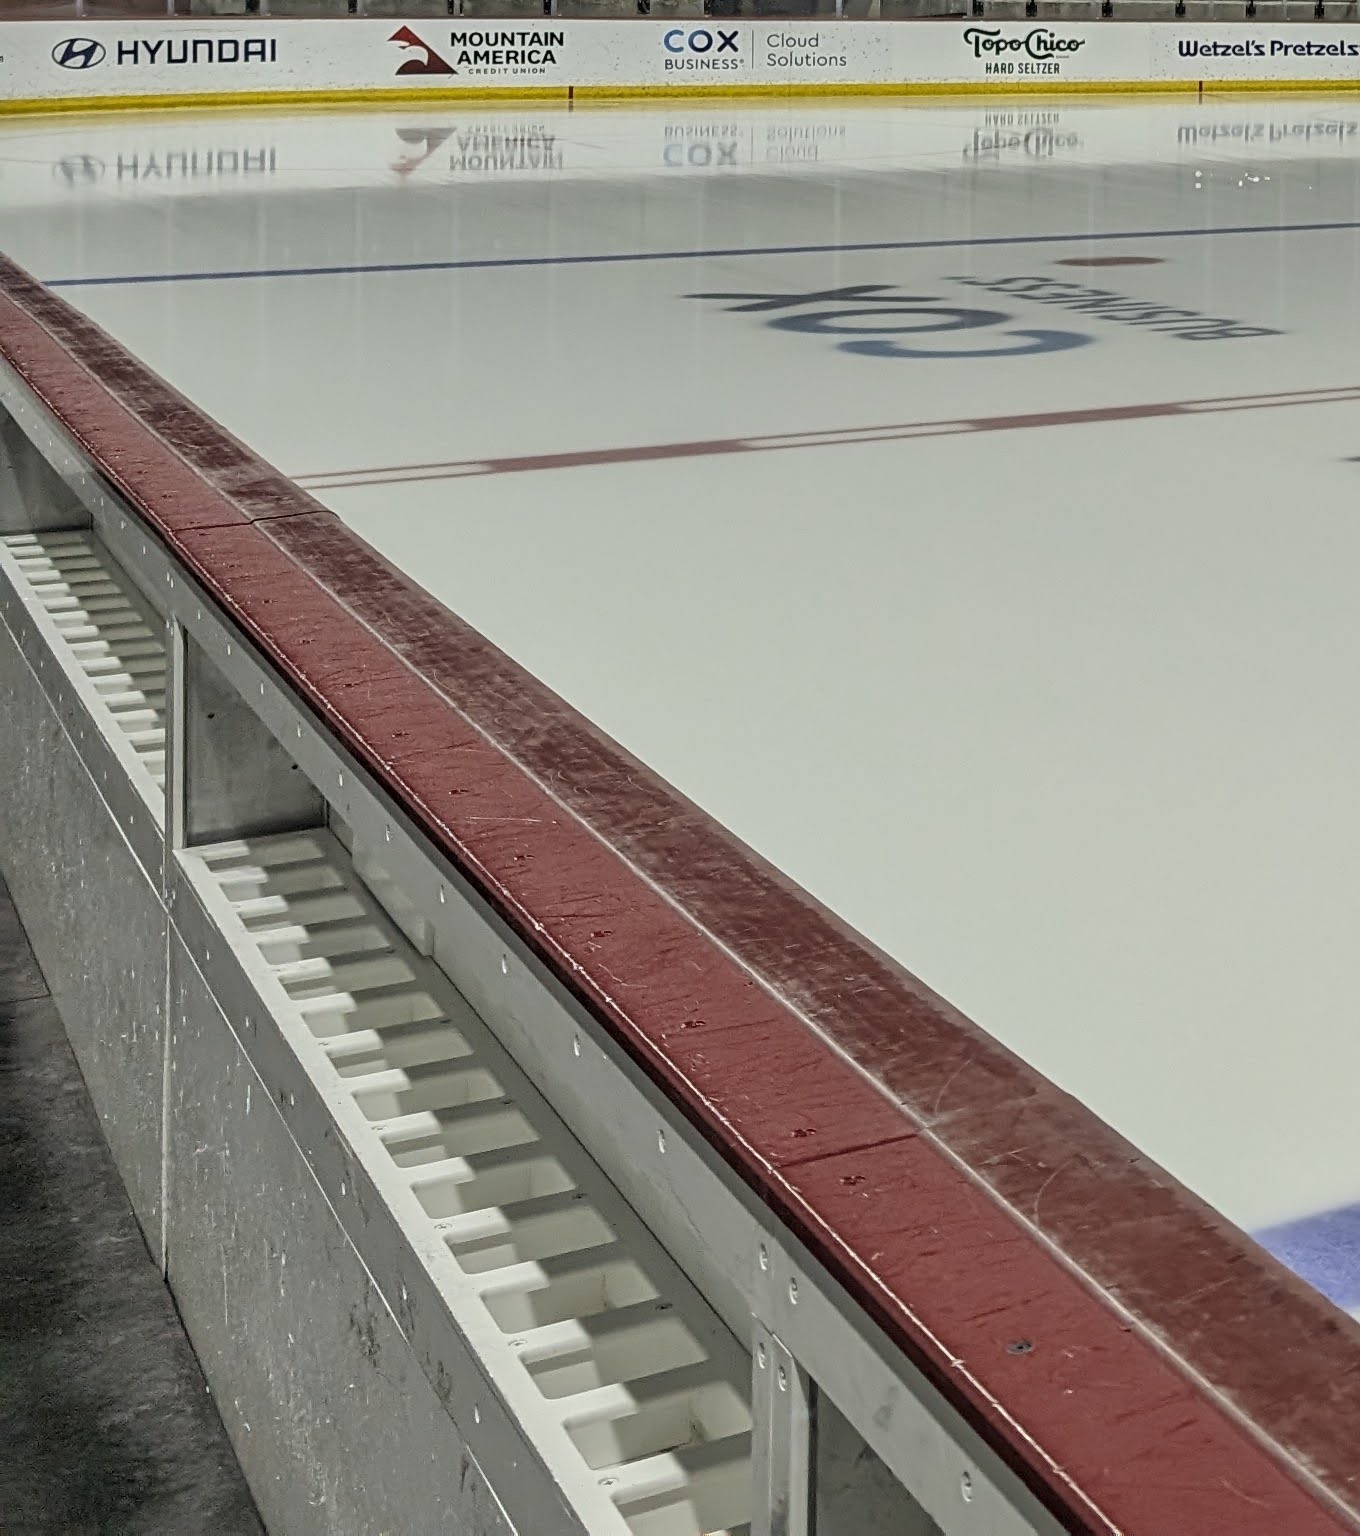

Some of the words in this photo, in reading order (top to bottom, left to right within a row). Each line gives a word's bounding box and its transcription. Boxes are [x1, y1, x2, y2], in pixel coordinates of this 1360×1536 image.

[450, 31, 565, 47] MOUNTAIN
[664, 29, 739, 53] COX
[766, 32, 819, 48] Cloud
[117, 38, 276, 65] HYUNDAI
[1178, 39, 1265, 57] Wetzel's
[1270, 39, 1359, 57] Pretzels
[457, 49, 557, 65] AMERICA
[664, 58, 739, 70] BUSINESS
[766, 51, 847, 67] Solutions
[468, 67, 508, 75] CREDIT
[512, 67, 546, 75] UNION
[985, 62, 1014, 74] HARD
[1017, 62, 1060, 75] SELTZER
[962, 275, 1287, 342] BUSINESS
[680, 283, 1101, 359] COX
